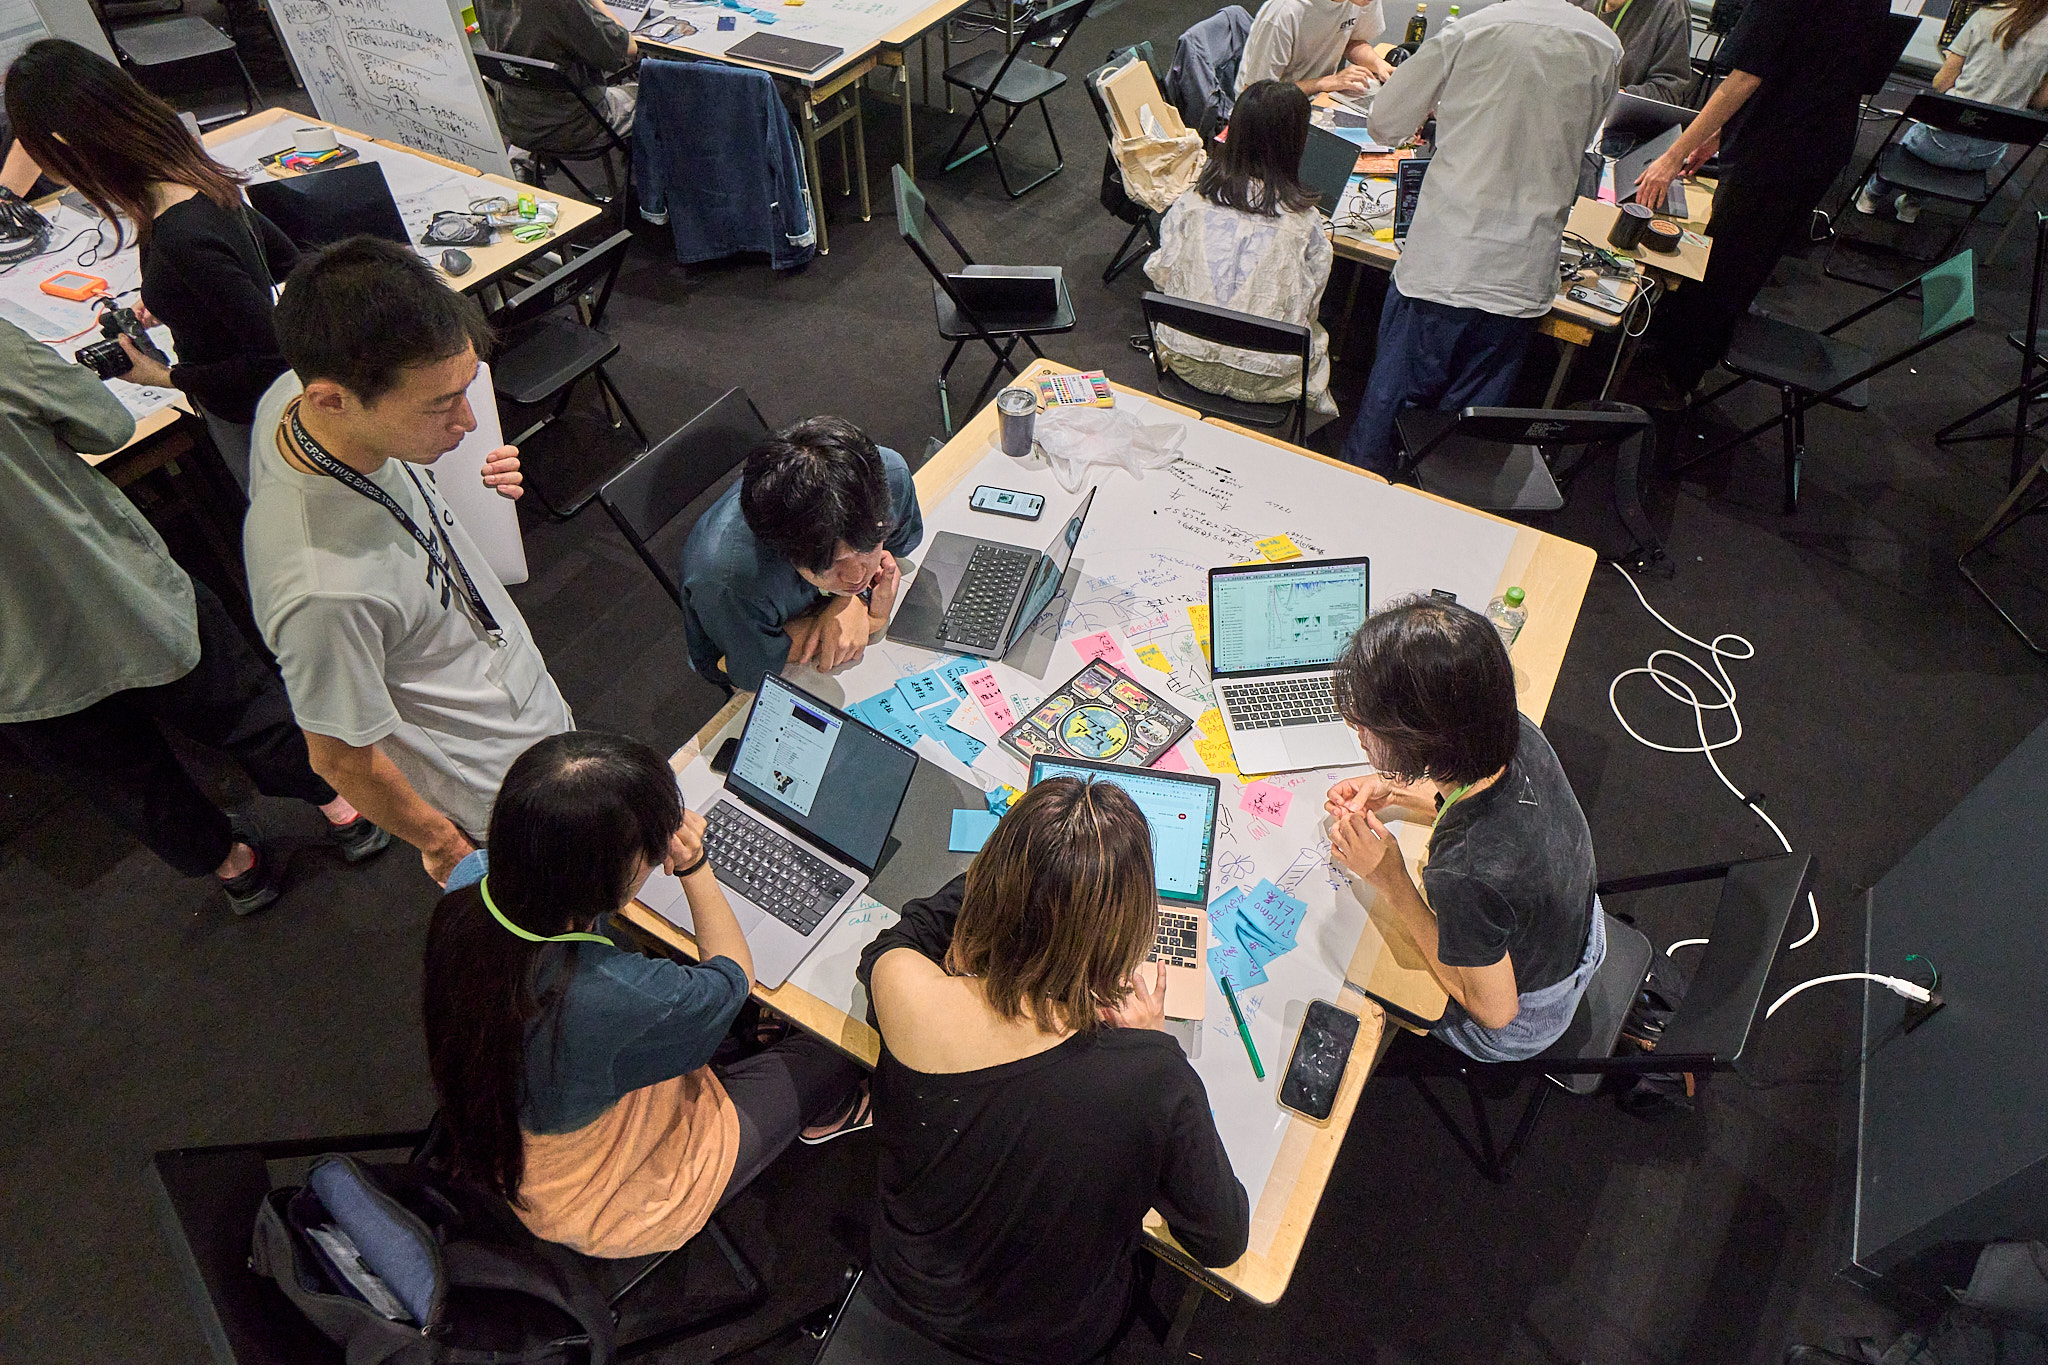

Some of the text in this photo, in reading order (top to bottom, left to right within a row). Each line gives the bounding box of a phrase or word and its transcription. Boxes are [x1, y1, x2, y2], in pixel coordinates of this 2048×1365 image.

[305, 441, 356, 483] CREATIVE
[354, 478, 381, 499] BASE
[1074, 722, 1105, 750] アース
[1078, 710, 1123, 747] プラネット
[849, 913, 871, 926] call
[1254, 902, 1287, 932] Homo
